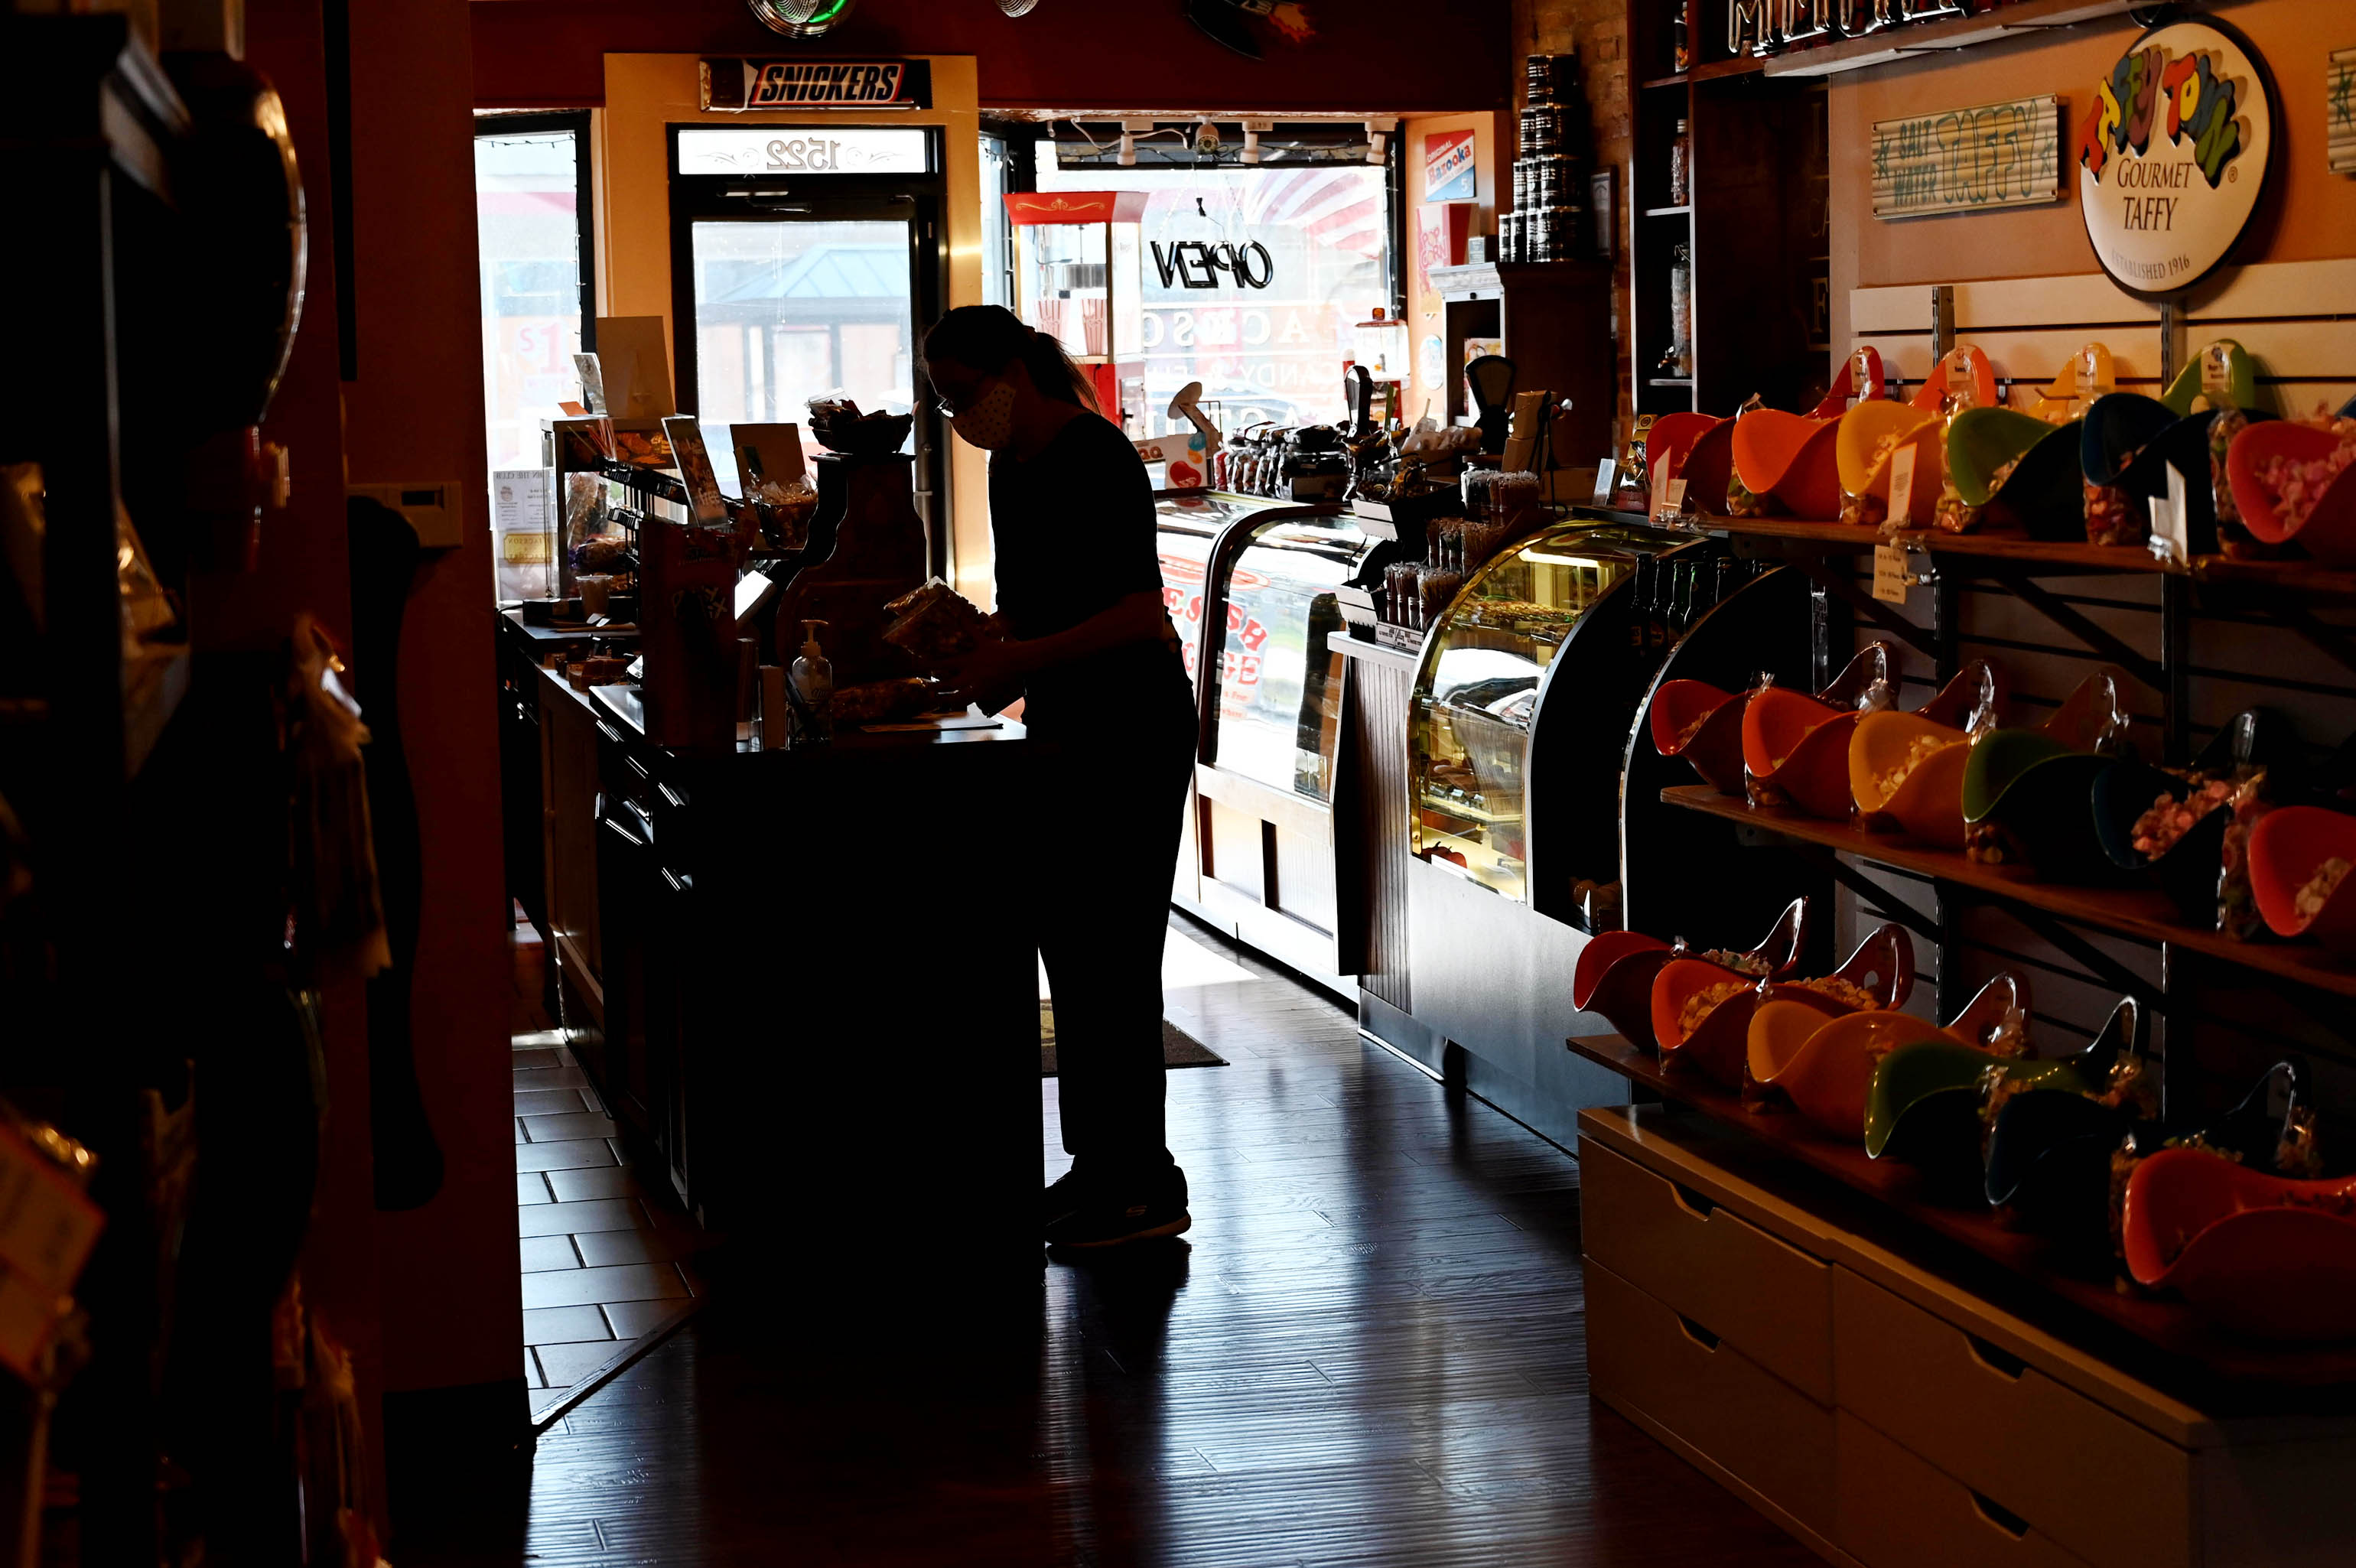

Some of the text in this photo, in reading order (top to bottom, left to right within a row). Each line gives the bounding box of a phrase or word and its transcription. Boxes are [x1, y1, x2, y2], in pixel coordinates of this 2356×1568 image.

[759, 65, 900, 102] SNICKERS
[1936, 98, 2039, 203] TAFFY
[2117, 158, 2194, 189] GOURMET
[2123, 197, 2179, 231] TAFFY
[2168, 252, 2190, 276] 1916
